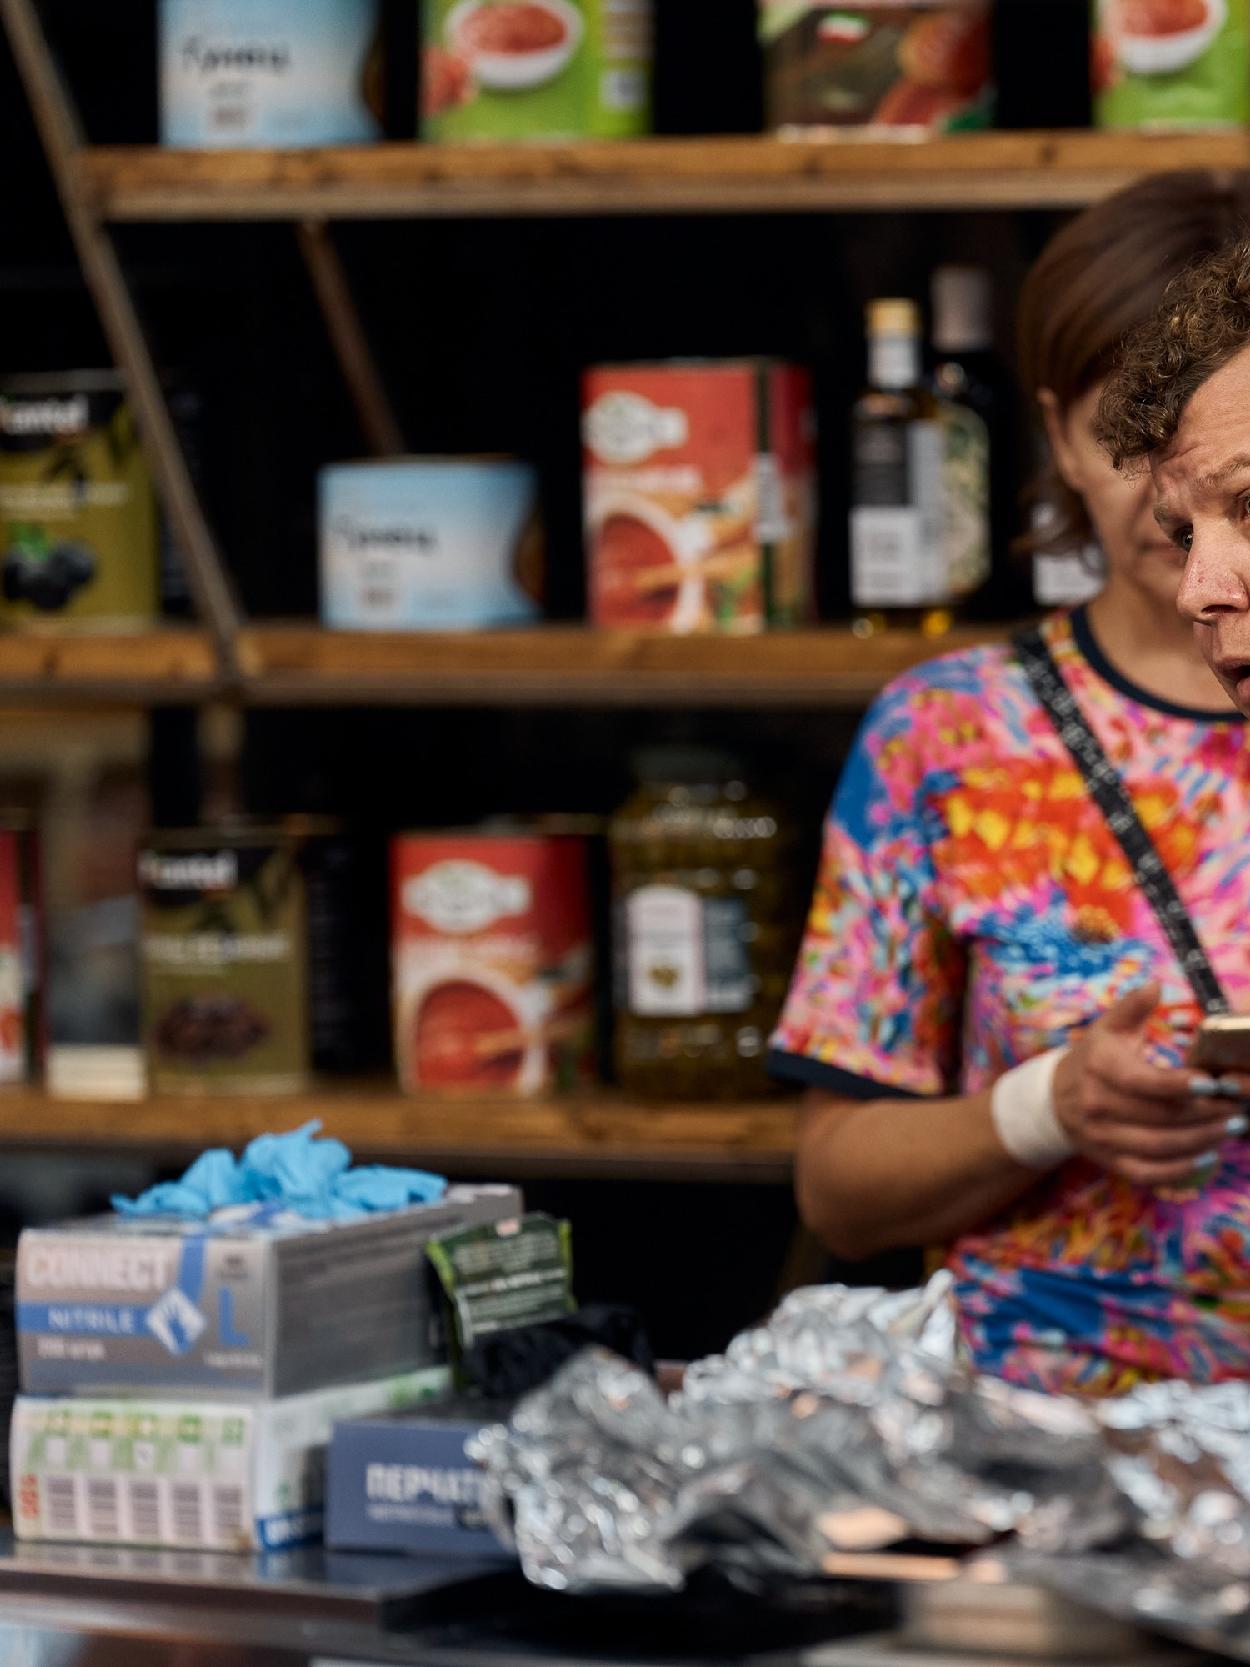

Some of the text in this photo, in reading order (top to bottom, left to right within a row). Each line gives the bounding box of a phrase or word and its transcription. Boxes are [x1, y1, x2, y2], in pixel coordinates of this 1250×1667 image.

[26, 1248, 169, 1289] CONNECT
[48, 1308, 135, 1334] NITRILE
[219, 1286, 250, 1346] L
